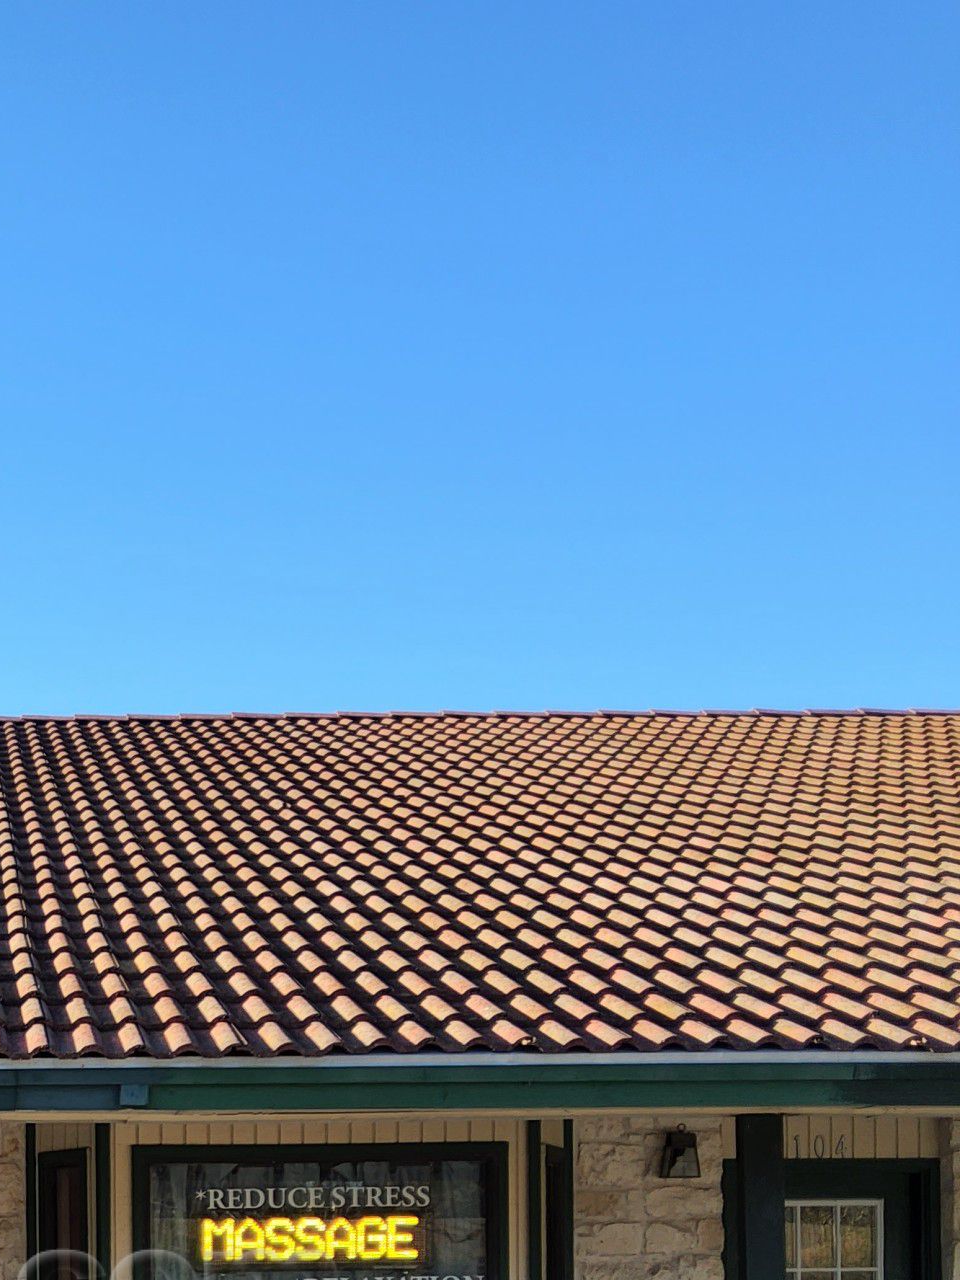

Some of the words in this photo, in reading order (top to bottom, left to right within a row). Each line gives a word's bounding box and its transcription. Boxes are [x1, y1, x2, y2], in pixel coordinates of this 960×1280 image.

[793, 1133, 848, 1159] 104
[331, 1185, 431, 1209] STRESS
[199, 1215, 420, 1262] MASSAGE
